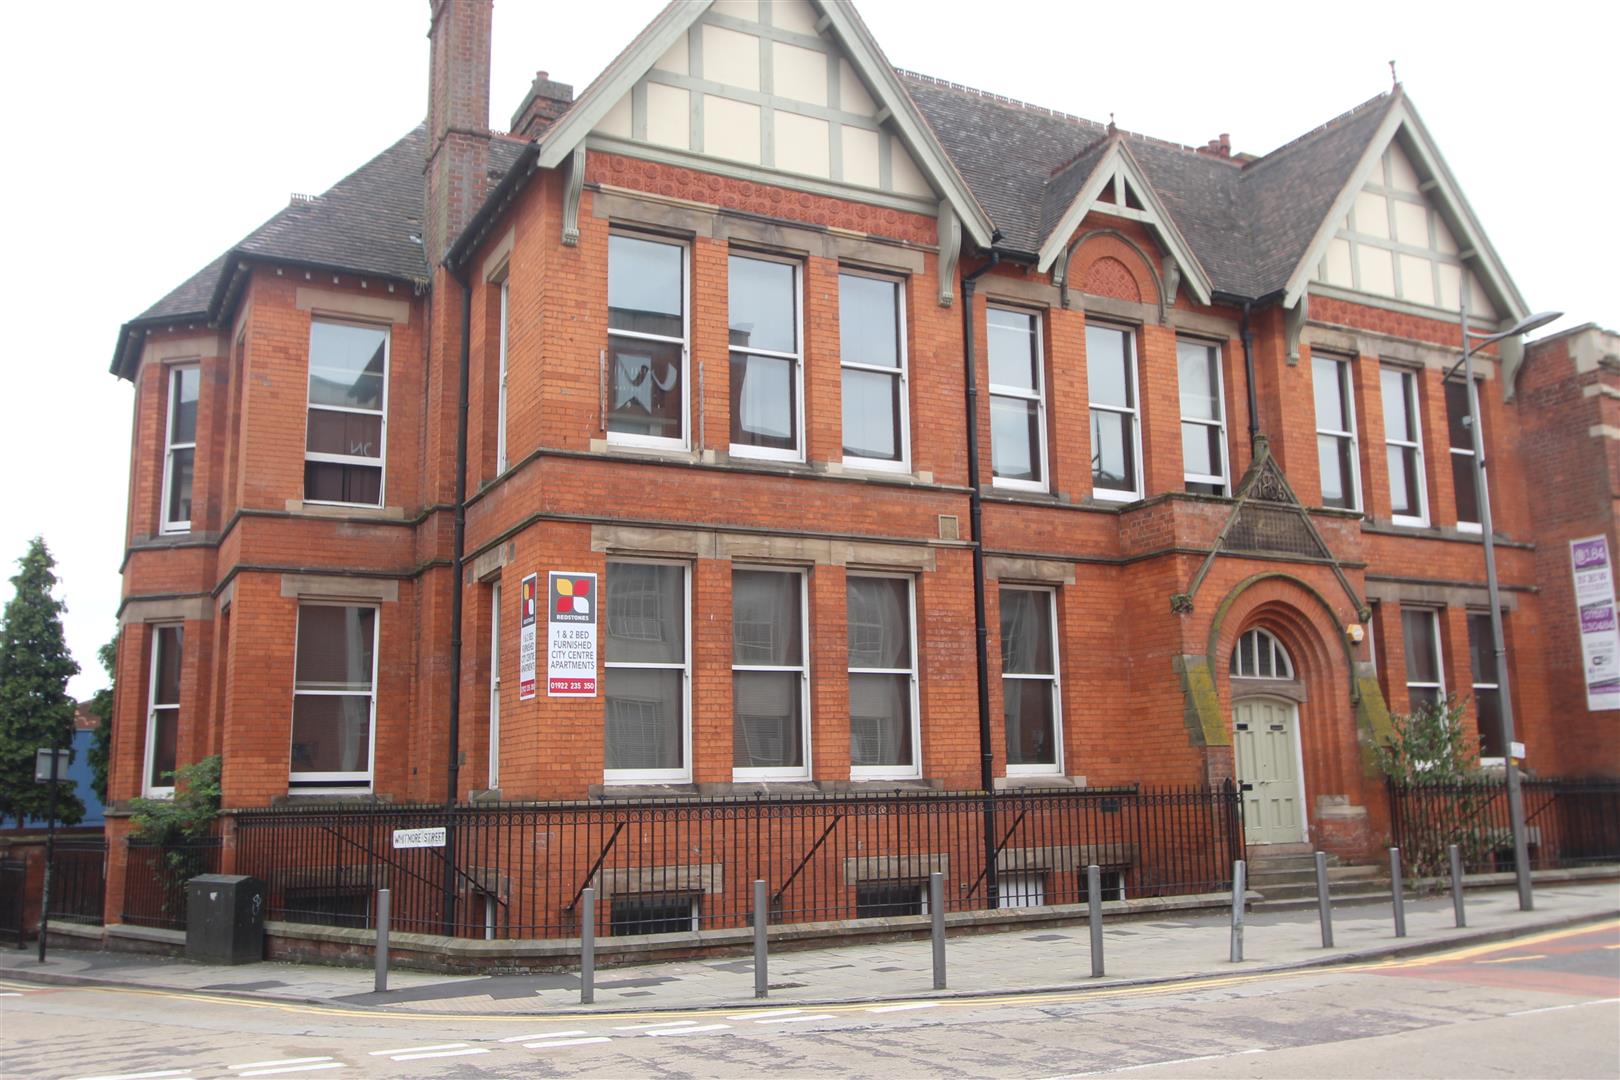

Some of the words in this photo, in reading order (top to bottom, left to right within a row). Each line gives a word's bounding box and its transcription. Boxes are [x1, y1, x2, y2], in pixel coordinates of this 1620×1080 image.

[556, 631, 560, 639] 1
[562, 631, 568, 639] &
[569, 631, 574, 639] 2
[575, 631, 589, 639] BED
[553, 641, 592, 649] FURNISHED
[551, 651, 567, 659] CITY
[568, 651, 594, 659] CENTRE
[550, 661, 595, 670] APARTMENTS
[551, 682, 568, 690] 01922
[570, 682, 581, 690] 235
[583, 682, 594, 690] 350
[424, 831, 445, 843] STREET
